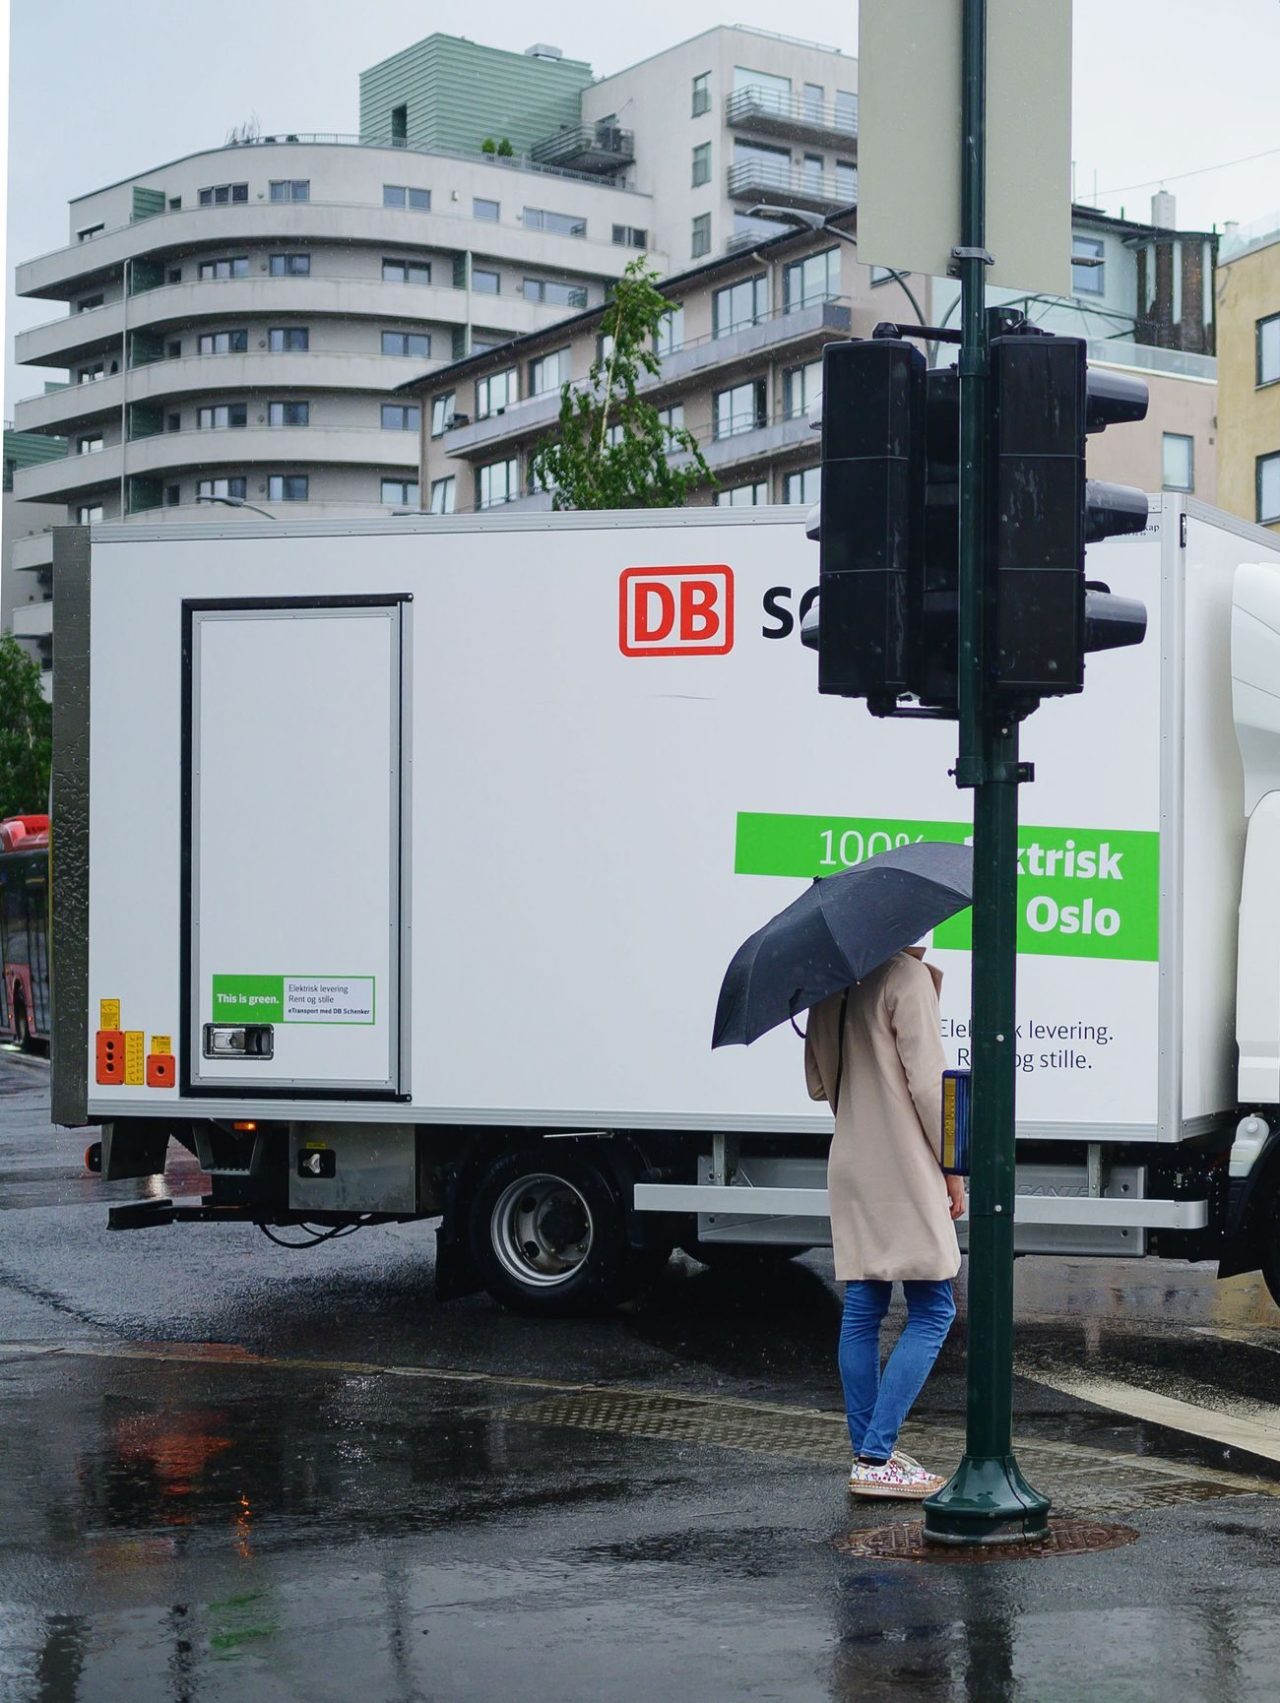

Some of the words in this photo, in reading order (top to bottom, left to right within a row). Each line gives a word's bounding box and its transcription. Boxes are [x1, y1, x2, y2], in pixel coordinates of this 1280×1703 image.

[631, 577, 723, 645] DB
[1026, 895, 1121, 937] Oslo
[288, 983, 318, 993] Elektrisk
[320, 984, 349, 995] levering
[217, 993, 237, 1004] This
[239, 993, 247, 1004] is
[249, 994, 279, 1006] green.
[288, 995, 305, 1003] Rent
[306, 997, 316, 1005] og
[318, 995, 335, 1004] stille
[288, 1007, 319, 1015] eTransport
[343, 1007, 370, 1015] Schenker
[1029, 1020, 1114, 1045] levering.
[1040, 1049, 1093, 1070] stille.
[1017, 1184, 1089, 1197] CANTE
